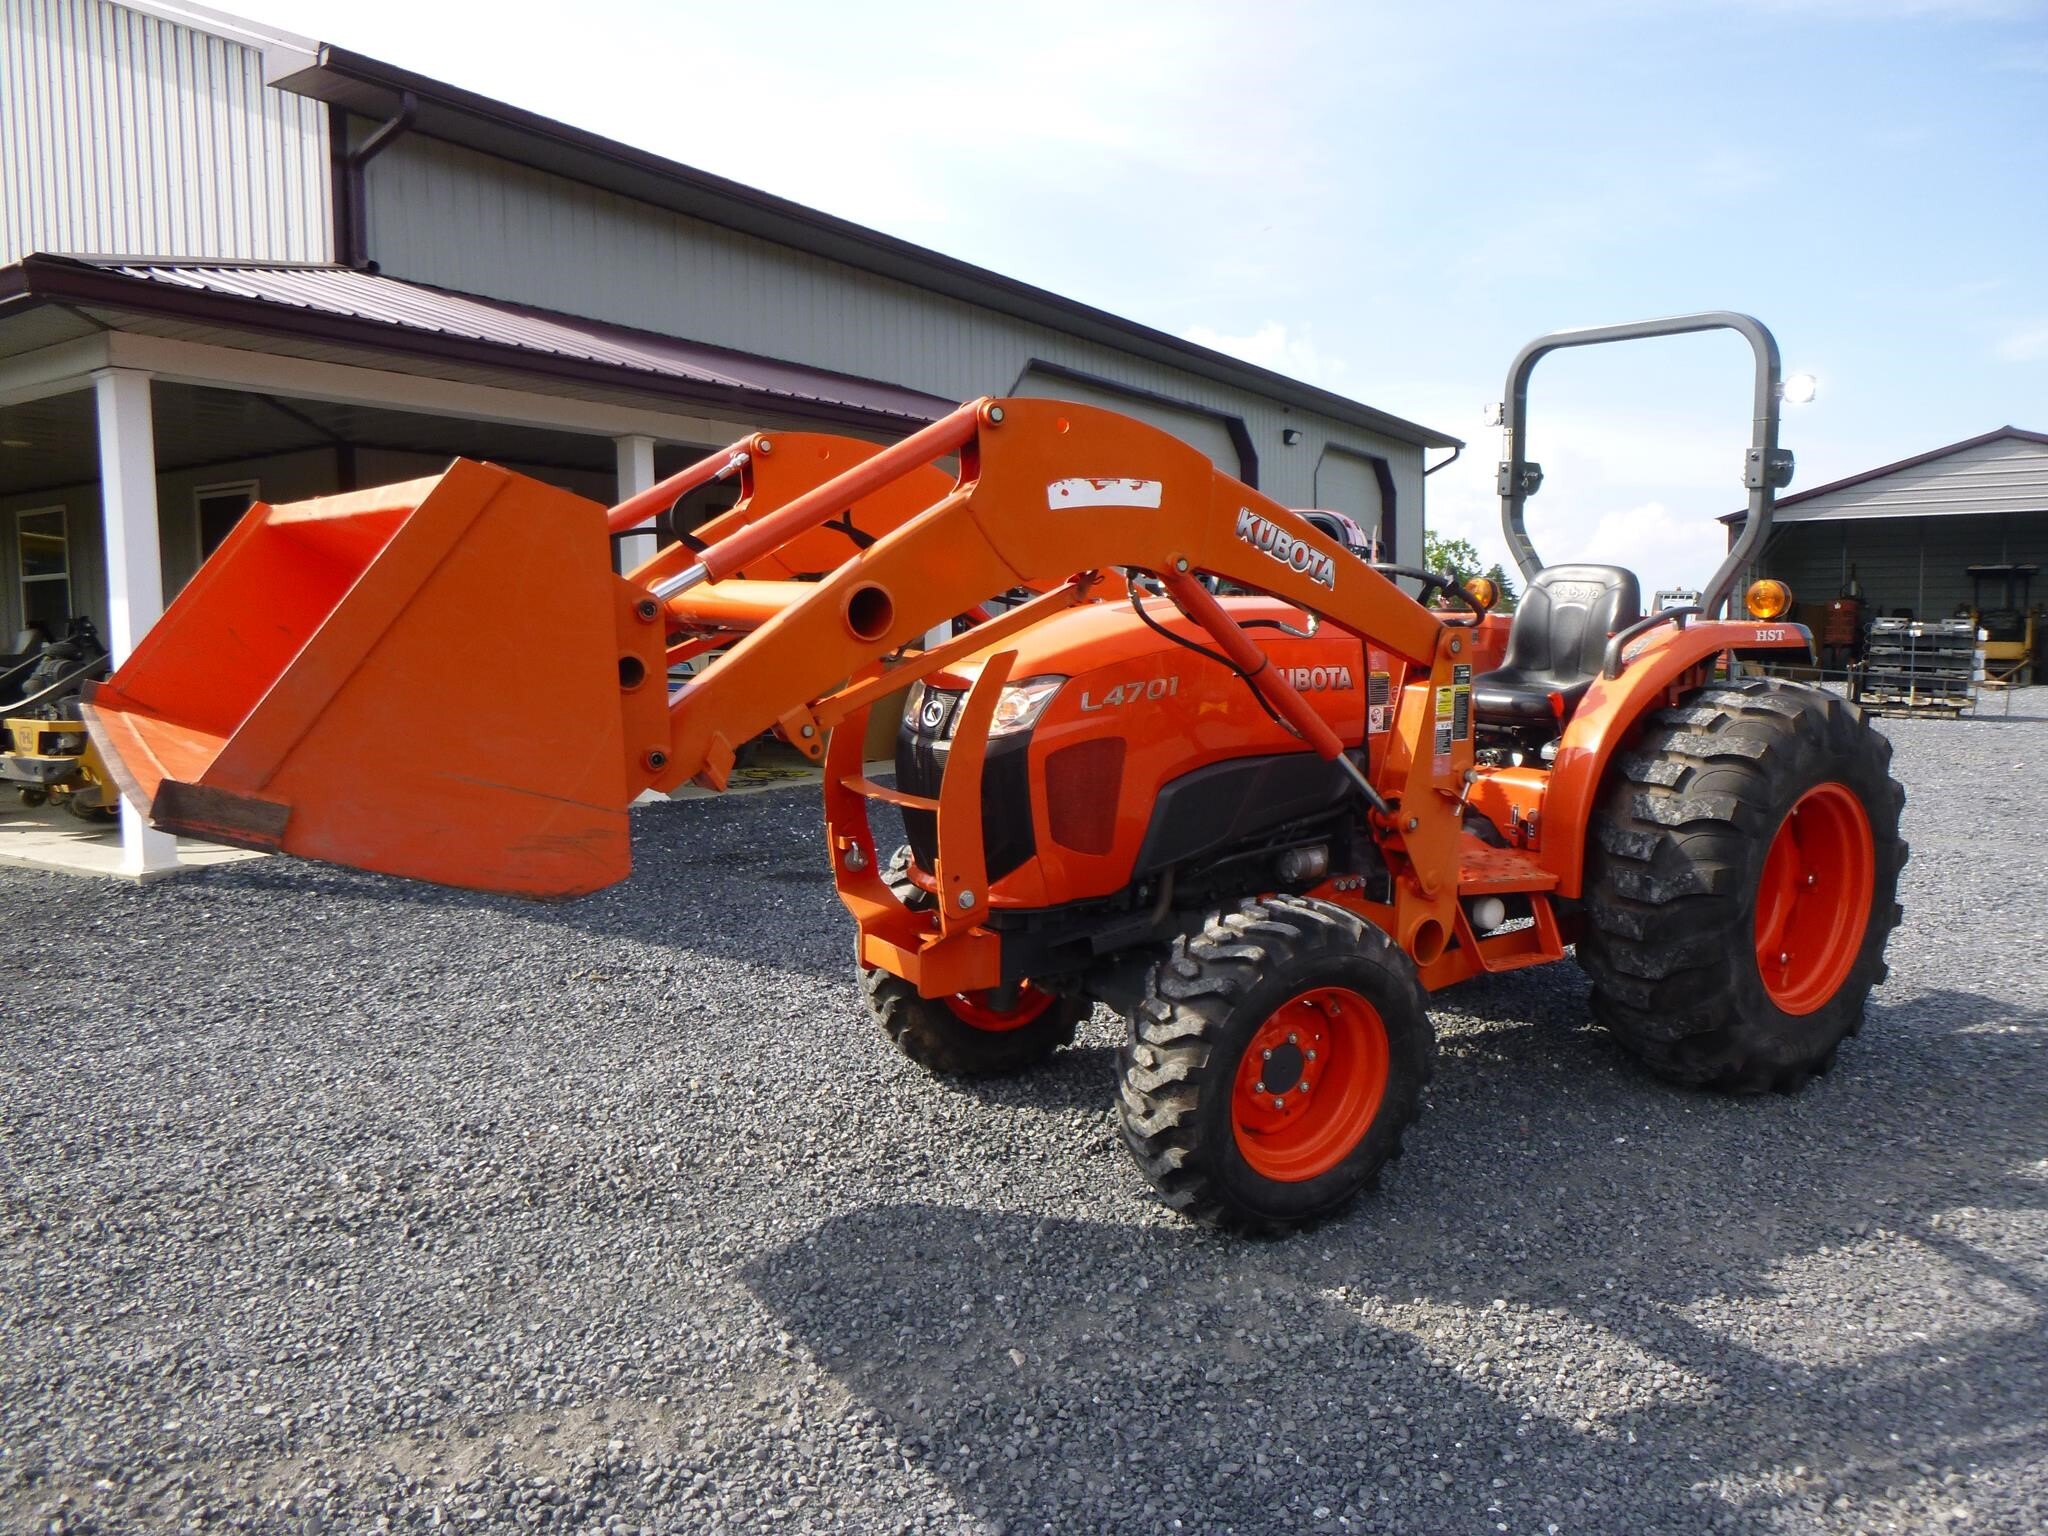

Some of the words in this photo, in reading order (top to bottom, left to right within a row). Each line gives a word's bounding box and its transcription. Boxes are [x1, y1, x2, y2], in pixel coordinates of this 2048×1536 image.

[1235, 507, 1335, 591] KUBOTA
[1755, 629, 1785, 641] HST
[1081, 676, 1179, 711] L4701
[1278, 666, 1354, 691] UBOTA
